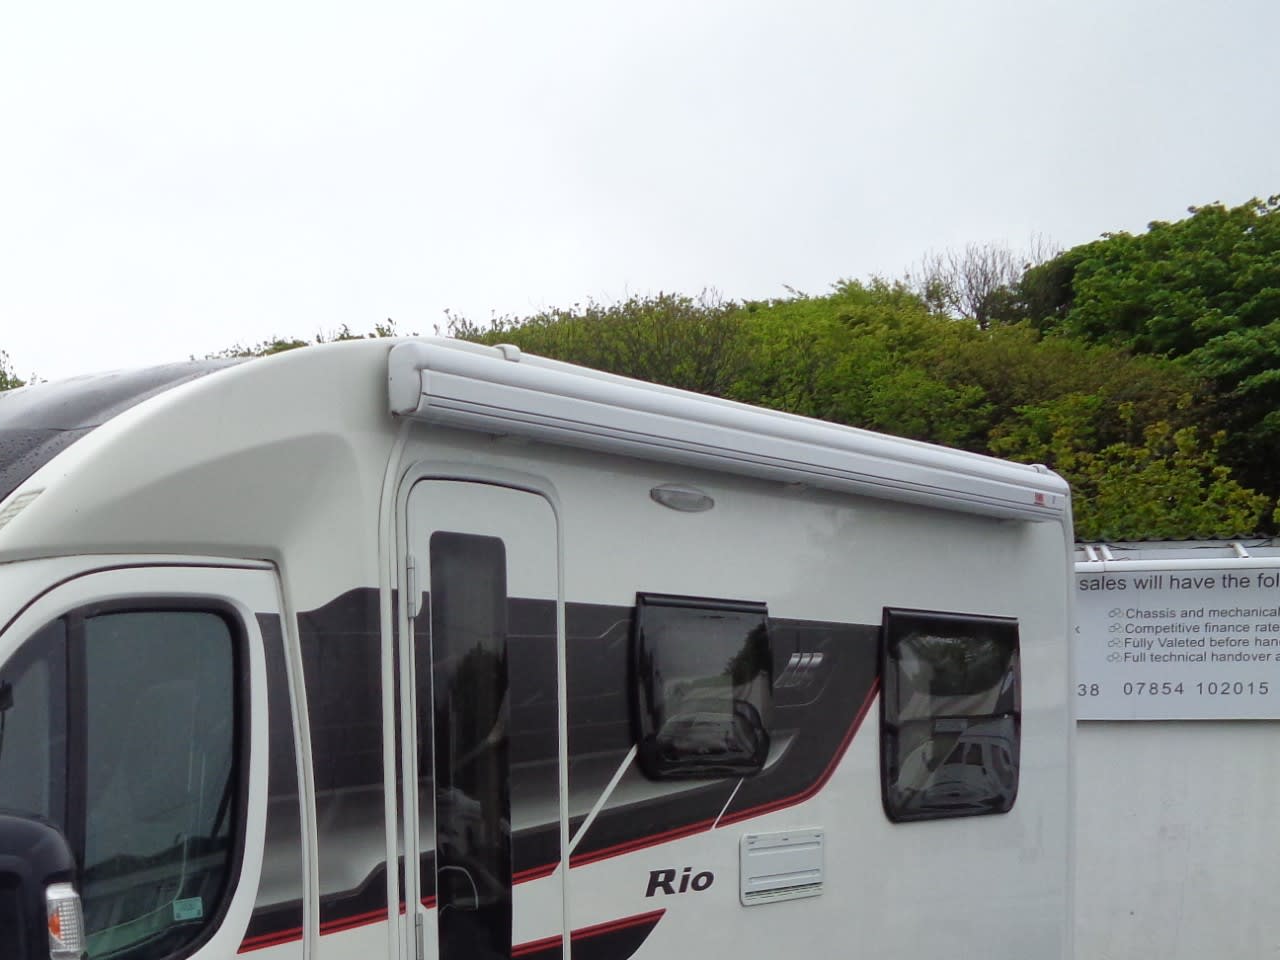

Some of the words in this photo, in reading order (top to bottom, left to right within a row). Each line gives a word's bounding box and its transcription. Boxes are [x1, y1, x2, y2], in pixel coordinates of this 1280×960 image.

[1079, 575, 1127, 591] sales
[1133, 575, 1163, 590] will
[1169, 574, 1216, 590] have
[1222, 573, 1251, 589] the
[1257, 572, 1280, 588] fol
[1125, 608, 1177, 619] Chassis
[1180, 607, 1204, 618] and
[1208, 606, 1280, 618] mechanical
[1125, 623, 1201, 636] Competitive
[1205, 622, 1250, 633] finance
[1124, 637, 1154, 650] Fully
[1158, 637, 1205, 648] Valeted
[1210, 636, 1250, 647] before
[1124, 651, 1146, 663] Full
[1150, 651, 1207, 663] technical
[1211, 651, 1272, 662] handover
[1077, 683, 1100, 697] 38
[1123, 682, 1185, 696] 07854
[1195, 681, 1270, 695] 102015
[645, 866, 715, 898] Rio
